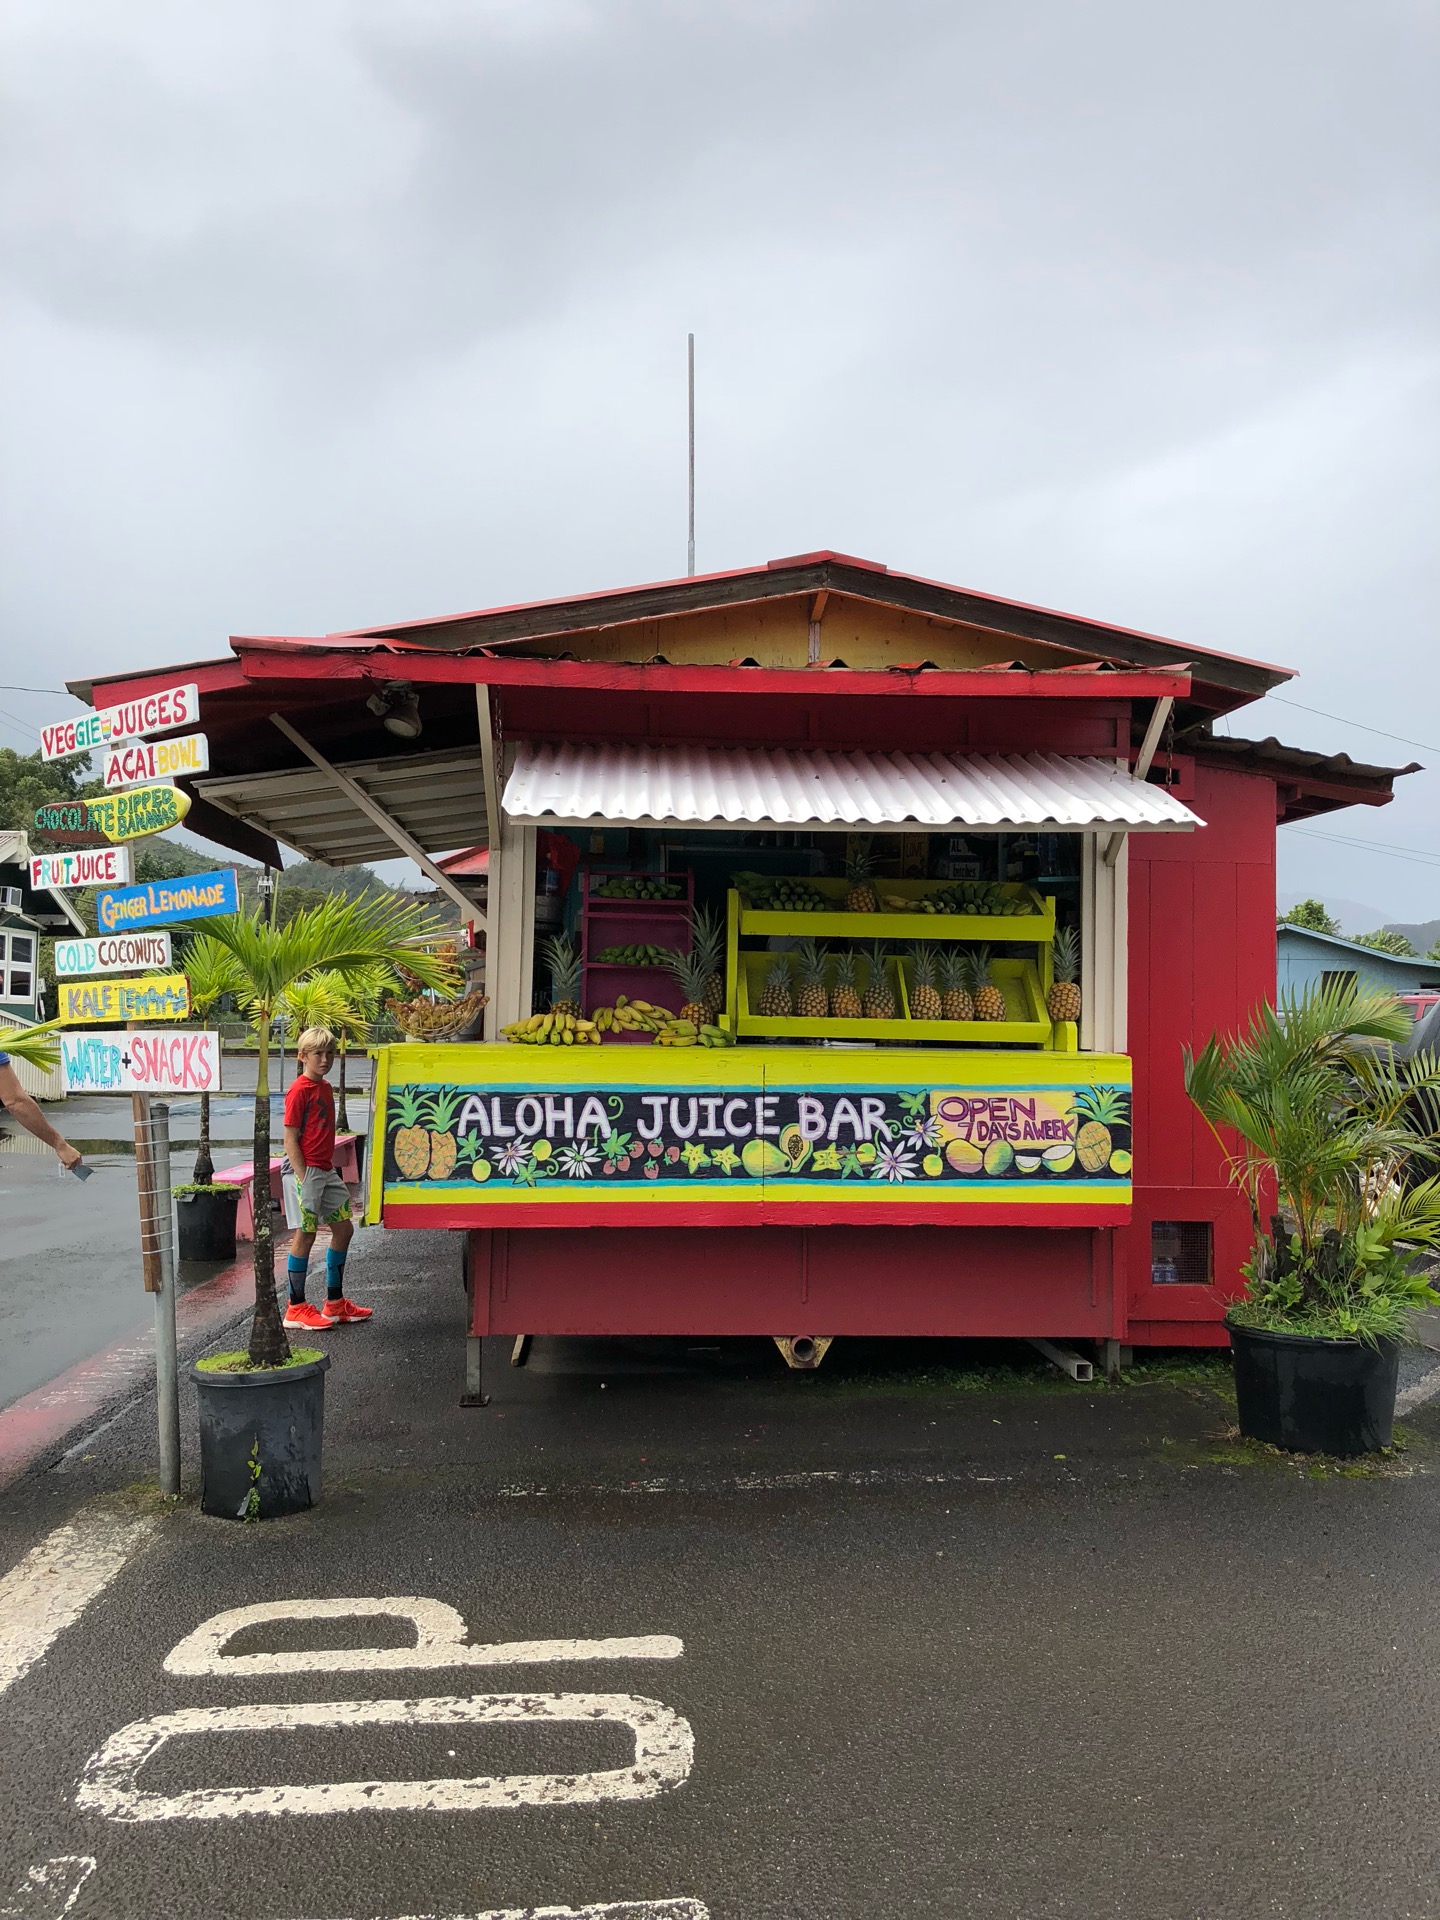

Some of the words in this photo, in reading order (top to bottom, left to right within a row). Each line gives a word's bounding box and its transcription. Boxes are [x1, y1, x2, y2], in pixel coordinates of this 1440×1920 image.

[42, 716, 101, 757] VEGGIE
[112, 689, 187, 736] JUICES
[107, 745, 155, 784] ACAI
[157, 738, 202, 774] BOWL
[34, 802, 115, 833] CHOCOLATE
[117, 788, 173, 815] DIPPED
[117, 801, 179, 837] BANANAS
[32, 857, 72, 886] FRUIT
[71, 851, 116, 884] JUICE
[101, 894, 147, 929] GINGER
[148, 884, 225, 914] LEMONADE
[56, 942, 96, 972] COLD
[98, 938, 166, 966] COCONUTS
[68, 985, 112, 1018] KALE
[62, 1038, 122, 1087] WATER
[131, 1036, 213, 1090] SNACKS
[457, 1095, 612, 1139] ALOHA
[636, 1096, 780, 1140] JUICE
[798, 1096, 893, 1142] BAR
[937, 1096, 1036, 1122] OPEN
[958, 1121, 975, 1142] 7
[977, 1120, 1021, 1141] DAYS
